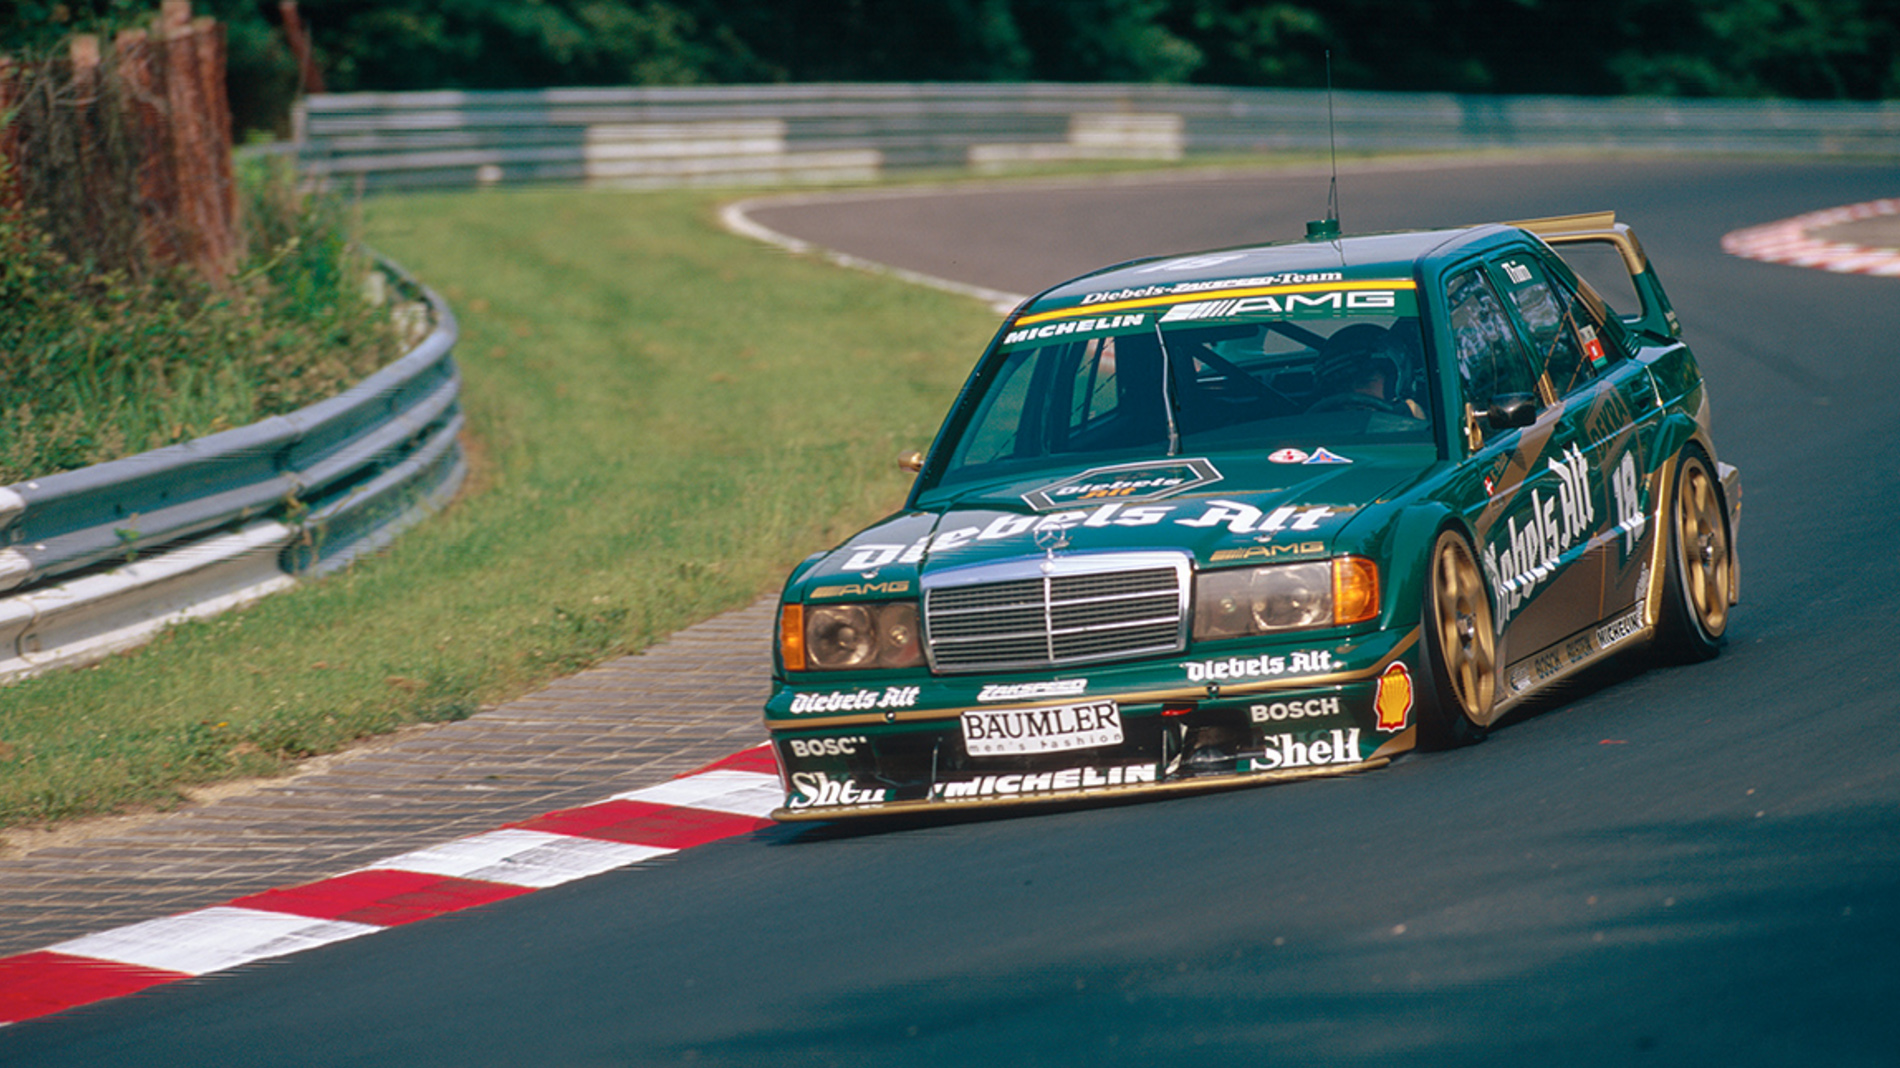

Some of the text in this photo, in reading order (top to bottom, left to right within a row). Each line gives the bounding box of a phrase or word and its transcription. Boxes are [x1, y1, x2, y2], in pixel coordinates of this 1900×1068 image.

[1227, 290, 1395, 317] AMG
[1003, 313, 1145, 344] MICHELIN
[1056, 477, 1184, 496] Diebels
[1077, 486, 1136, 499] Alt
[1548, 441, 1594, 549] Alt
[841, 500, 1335, 570] Diebels Alt
[1243, 541, 1325, 559] AMG
[838, 580, 910, 597] AMG
[1185, 650, 1332, 682] Diebels Alt
[789, 686, 920, 714] Diebels Alt
[1250, 697, 1340, 722] BOSCH
[964, 702, 1119, 741] BÄUMLER
[790, 736, 868, 758] BOSC
[968, 741, 1026, 752] men's
[1250, 727, 1363, 771] Shell
[943, 763, 1158, 799] MICHELIN
